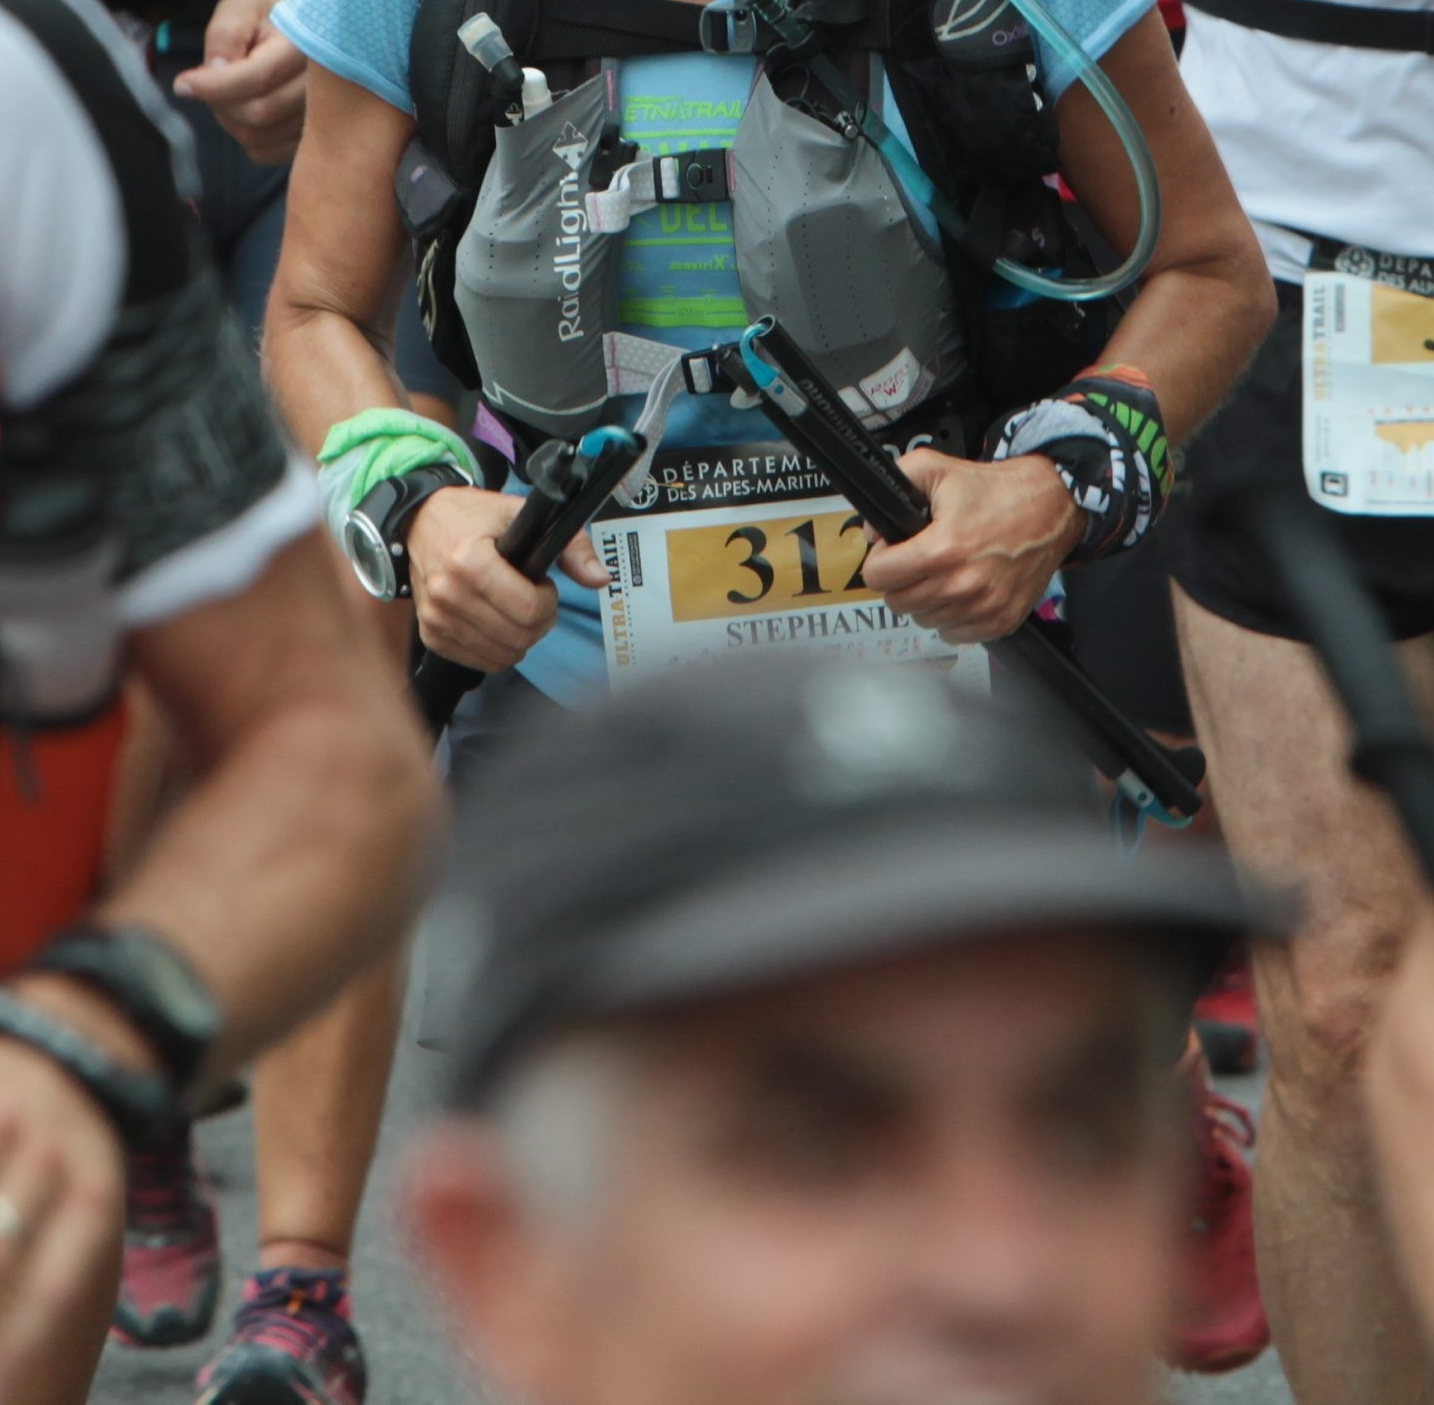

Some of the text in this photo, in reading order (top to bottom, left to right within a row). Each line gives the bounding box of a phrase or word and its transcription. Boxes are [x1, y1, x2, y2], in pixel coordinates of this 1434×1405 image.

[554, 171, 588, 343] RaidLight
[667, 480, 696, 503] DES
[726, 605, 910, 648] STEPHANIE
